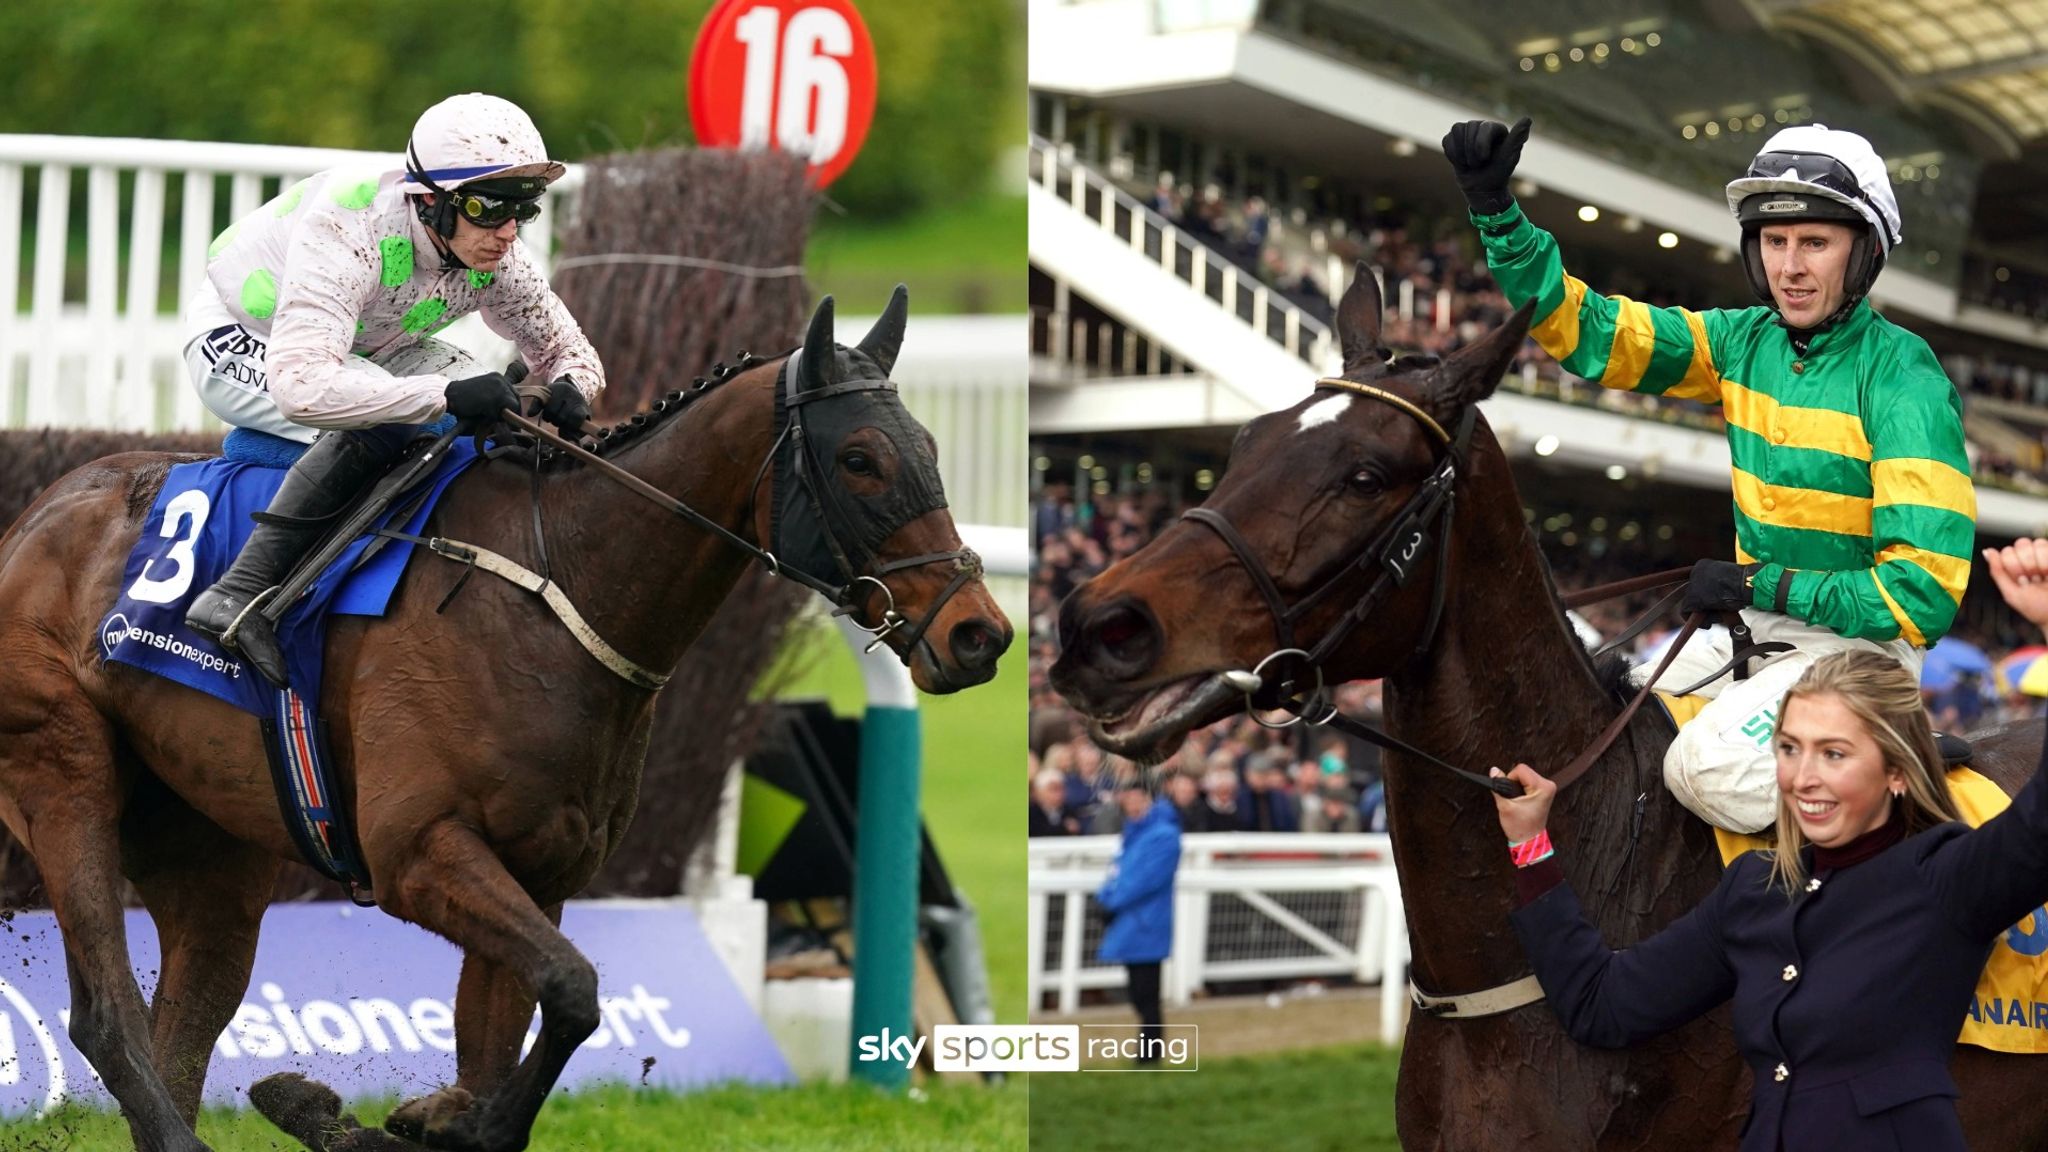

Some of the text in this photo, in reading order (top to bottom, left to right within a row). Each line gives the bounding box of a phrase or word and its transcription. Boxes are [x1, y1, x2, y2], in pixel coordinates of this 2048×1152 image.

[735, 6, 853, 165] 16
[128, 490, 210, 603] 3
[1390, 532, 1422, 578] 13
